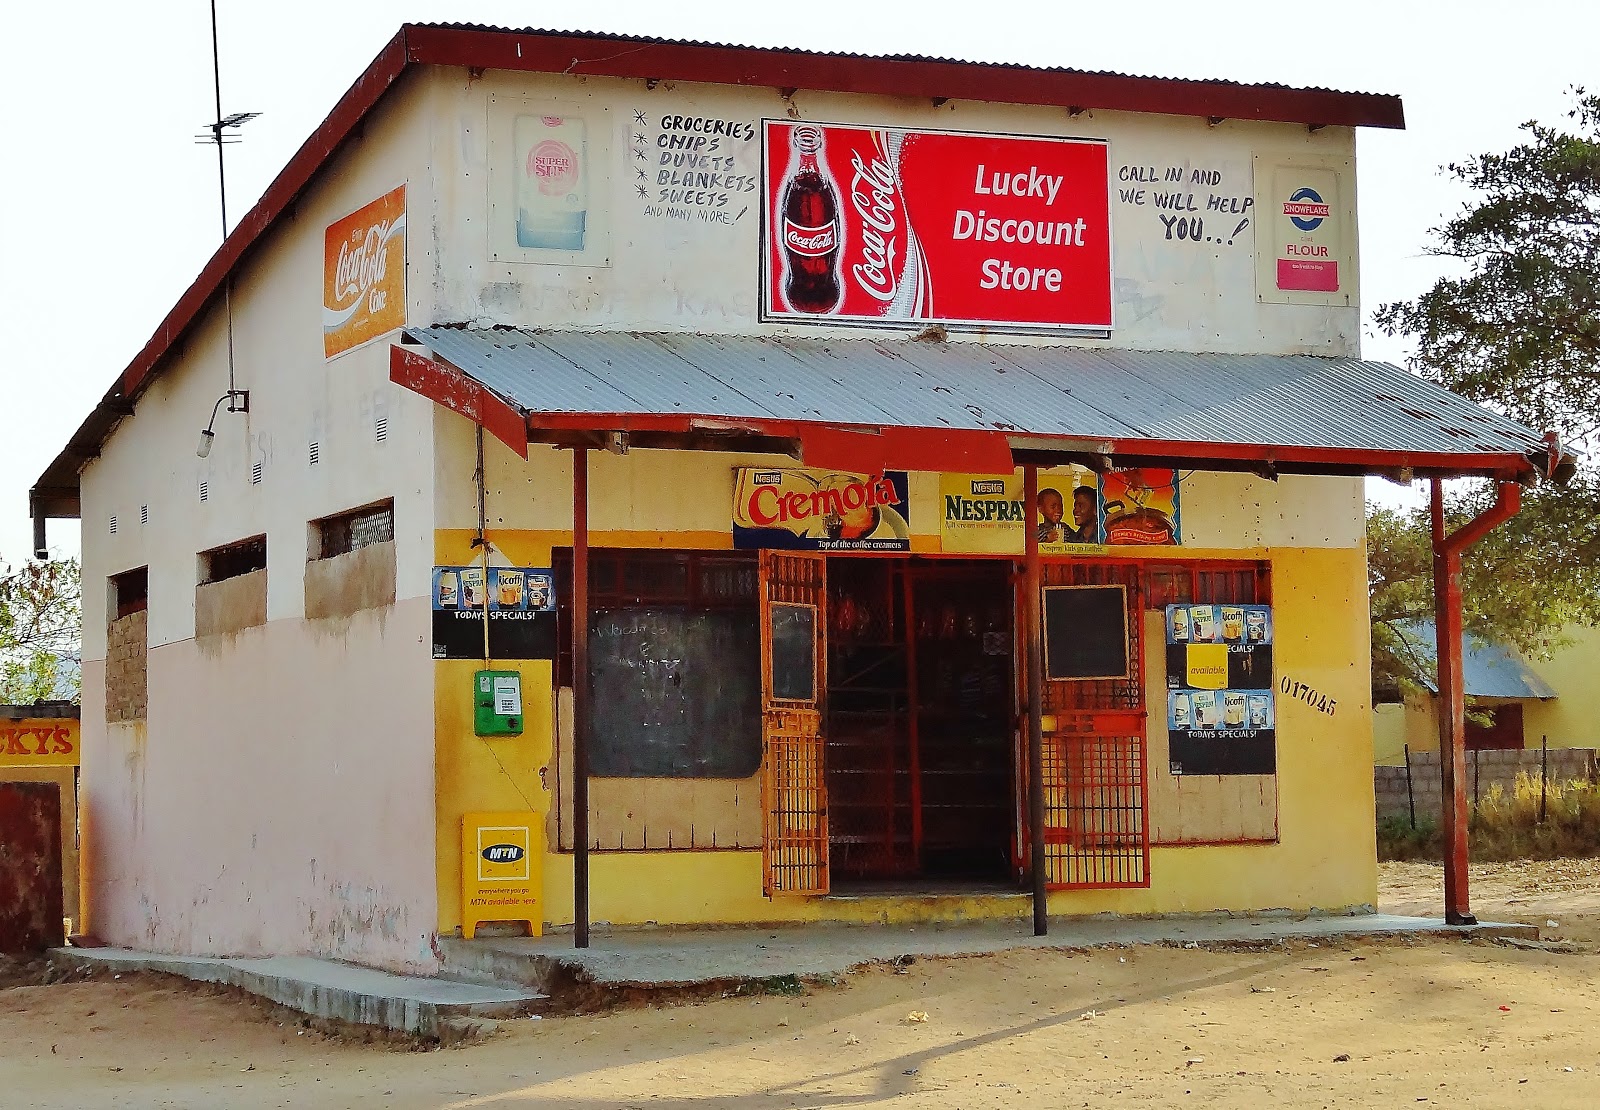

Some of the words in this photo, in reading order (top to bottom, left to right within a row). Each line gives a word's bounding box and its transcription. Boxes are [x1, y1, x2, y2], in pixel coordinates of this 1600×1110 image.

[661, 115, 755, 141] GROCERIES
[656, 134, 720, 151] CHIPS
[535, 157, 569, 166] SUPER
[659, 151, 735, 172] DUVETS
[656, 170, 756, 192] BLANKETS
[974, 164, 1064, 206] Lucky
[1118, 165, 1160, 183] CALL
[1164, 167, 1183, 183] IN
[1190, 169, 1222, 186] AND
[657, 188, 728, 207] SWEETS
[1118, 187, 1146, 206] WE
[1153, 190, 1199, 212] WILL
[1206, 194, 1254, 214] HELP
[644, 205, 662, 217] AND
[666, 206, 692, 221] MANY
[1284, 204, 1328, 215] SNOWFLAKE
[851, 149, 897, 302] Coca-Cola
[952, 209, 1087, 247] Discount
[788, 230, 834, 250] Coca-Cola
[1287, 245, 1329, 257] FLOUR
[979, 258, 1063, 293] Store
[748, 476, 899, 525] Cremora
[818, 540, 832, 549] Top
[831, 539, 840, 548] of
[840, 540, 850, 548] the
[850, 540, 872, 549] coffee
[872, 541, 902, 549] creamers
[453, 611, 485, 620] TODAYS
[490, 611, 535, 620] SPECIALS!
[1228, 645, 1254, 653] ECIALS!
[1281, 676, 1337, 716] 017045
[0, 725, 73, 754] KY'S
[1187, 730, 1215, 739] TODAYS
[1218, 730, 1257, 738] SPECIALS!
[490, 848, 518, 859] MTN
[488, 897, 519, 905] available
